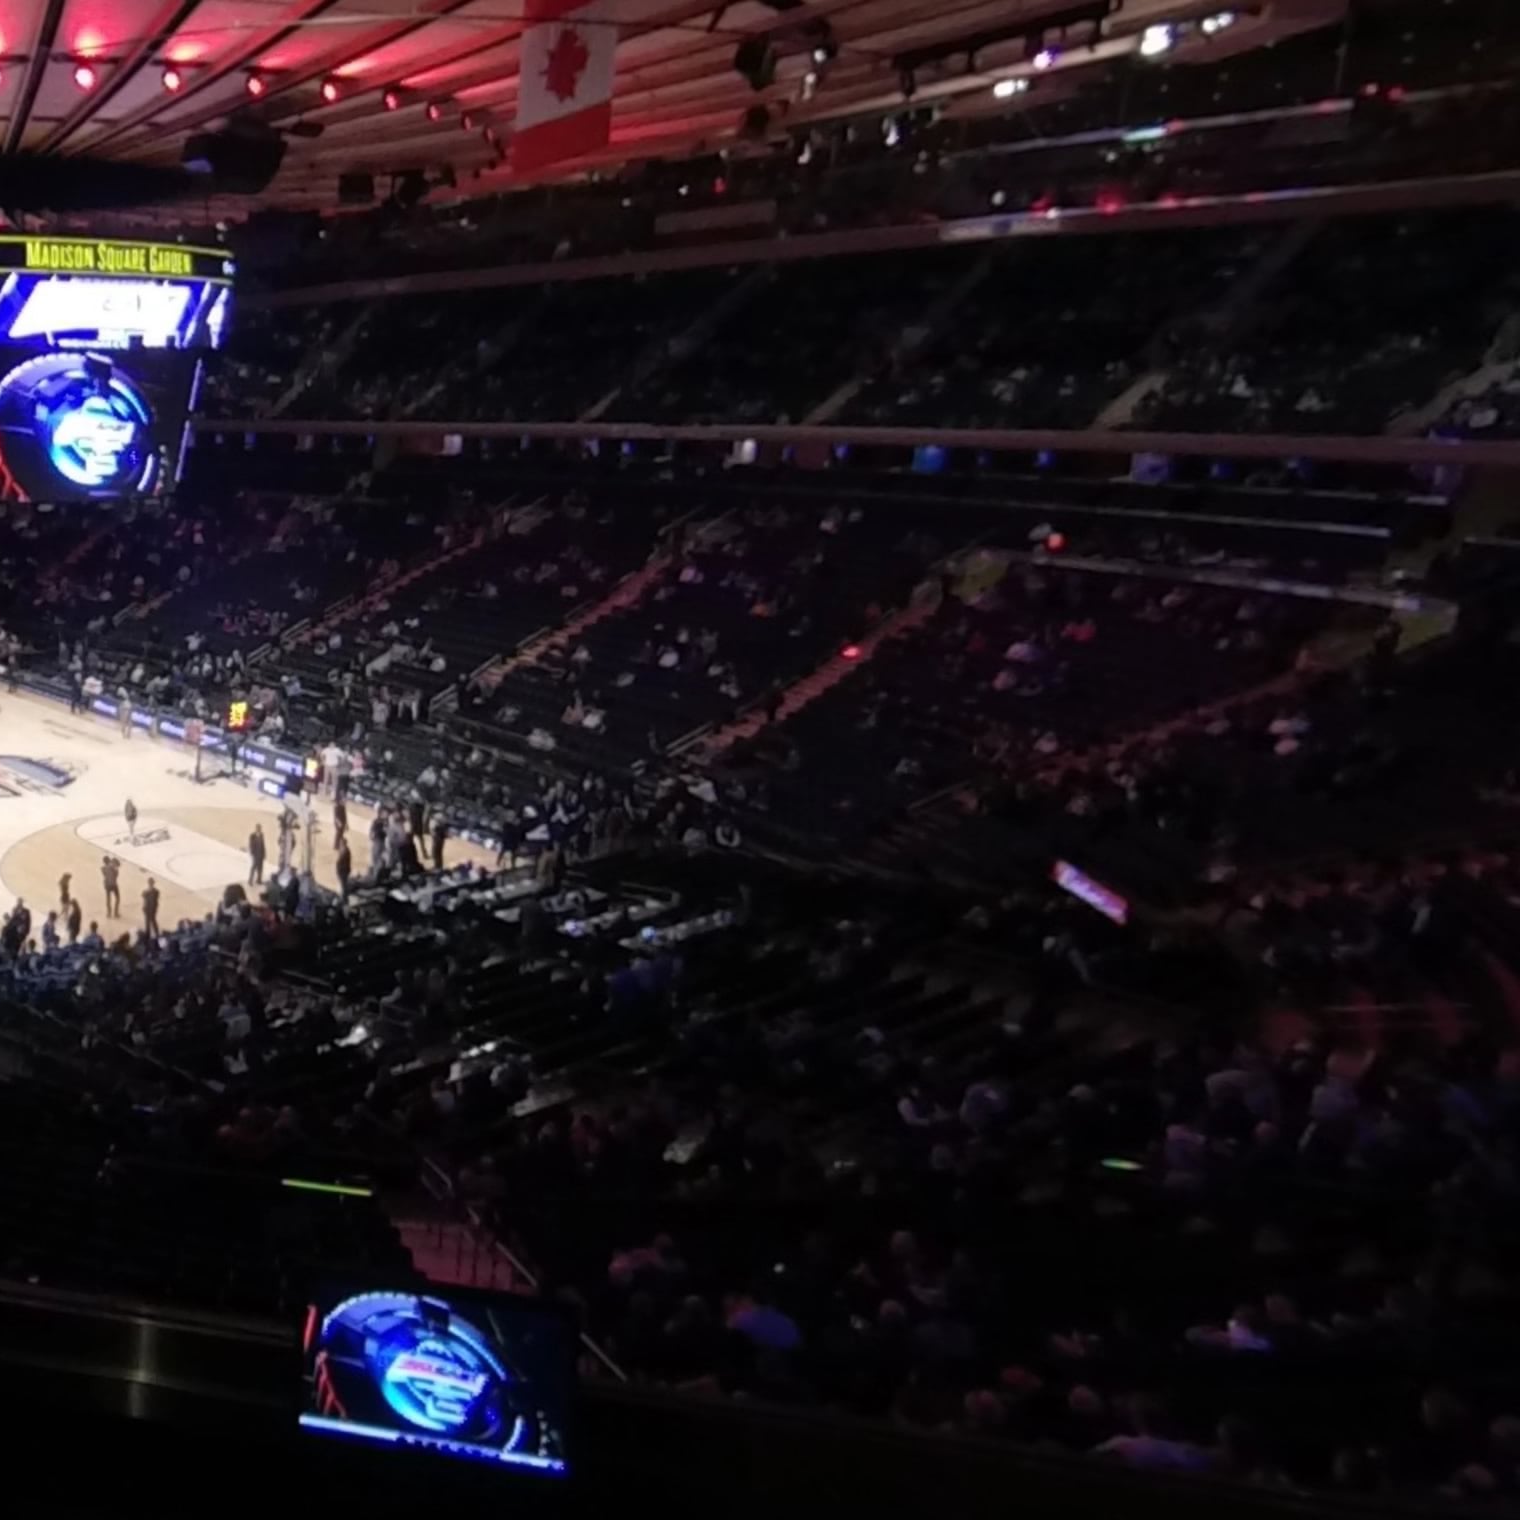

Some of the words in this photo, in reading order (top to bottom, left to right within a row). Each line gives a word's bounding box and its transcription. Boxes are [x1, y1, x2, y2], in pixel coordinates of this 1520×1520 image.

[27, 241, 94, 269] MADISON
[97, 242, 146, 272] SQUARE
[149, 246, 192, 273] GARDEN
